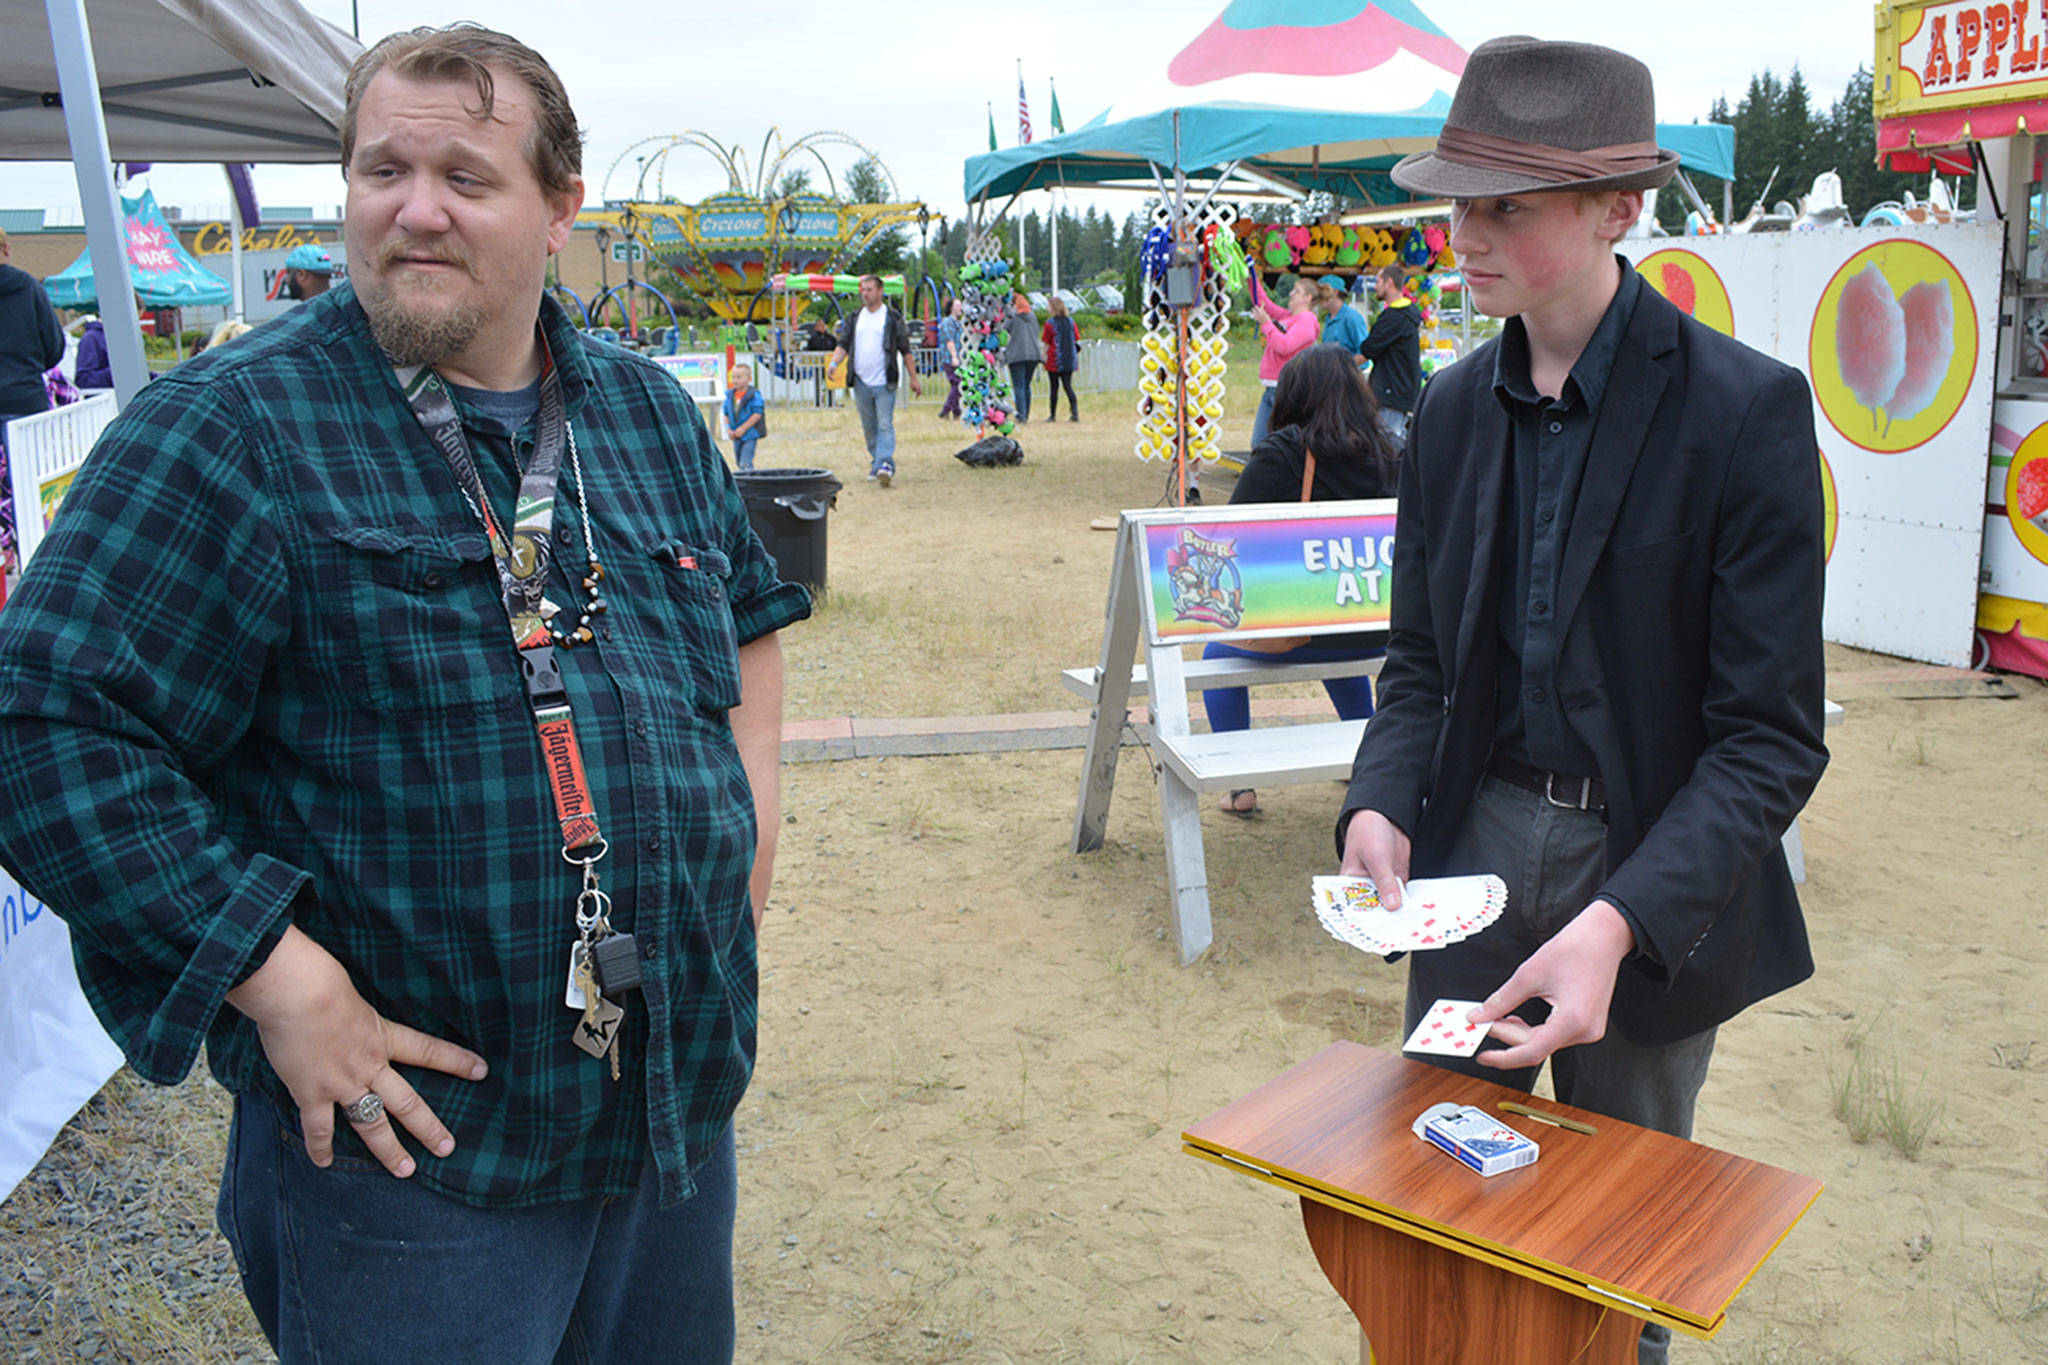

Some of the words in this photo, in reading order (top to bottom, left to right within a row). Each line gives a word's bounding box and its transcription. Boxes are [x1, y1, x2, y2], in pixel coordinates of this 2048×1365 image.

[1924, 0, 2048, 87] APPL
[701, 217, 763, 232] CYCLONE
[1183, 529, 1230, 557] BUTLER
[1335, 569, 1383, 606] AT
